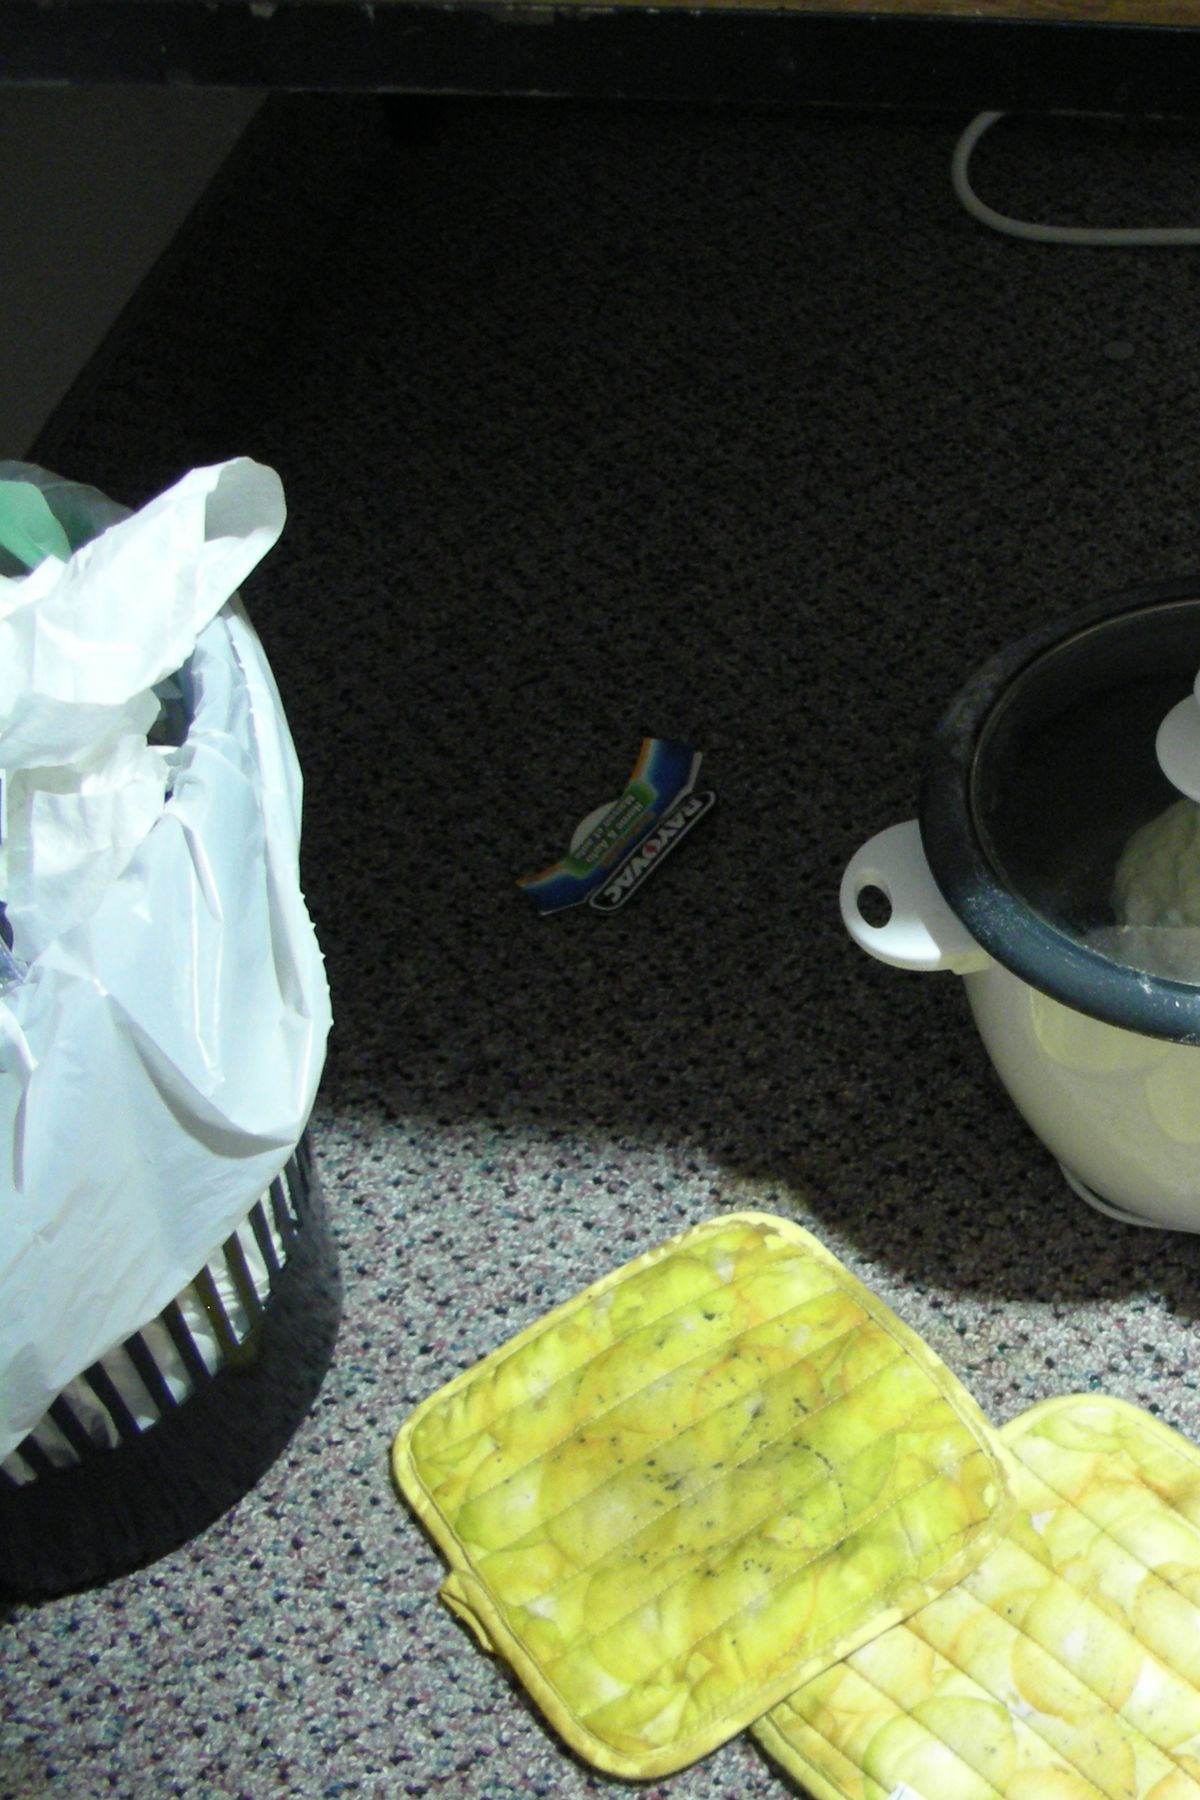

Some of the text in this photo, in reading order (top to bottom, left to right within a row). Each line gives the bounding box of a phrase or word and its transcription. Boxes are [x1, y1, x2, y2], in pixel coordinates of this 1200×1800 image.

[616, 801, 644, 829] Home
[586, 839, 608, 863] Auto
[604, 799, 704, 903] RAYOVAC
